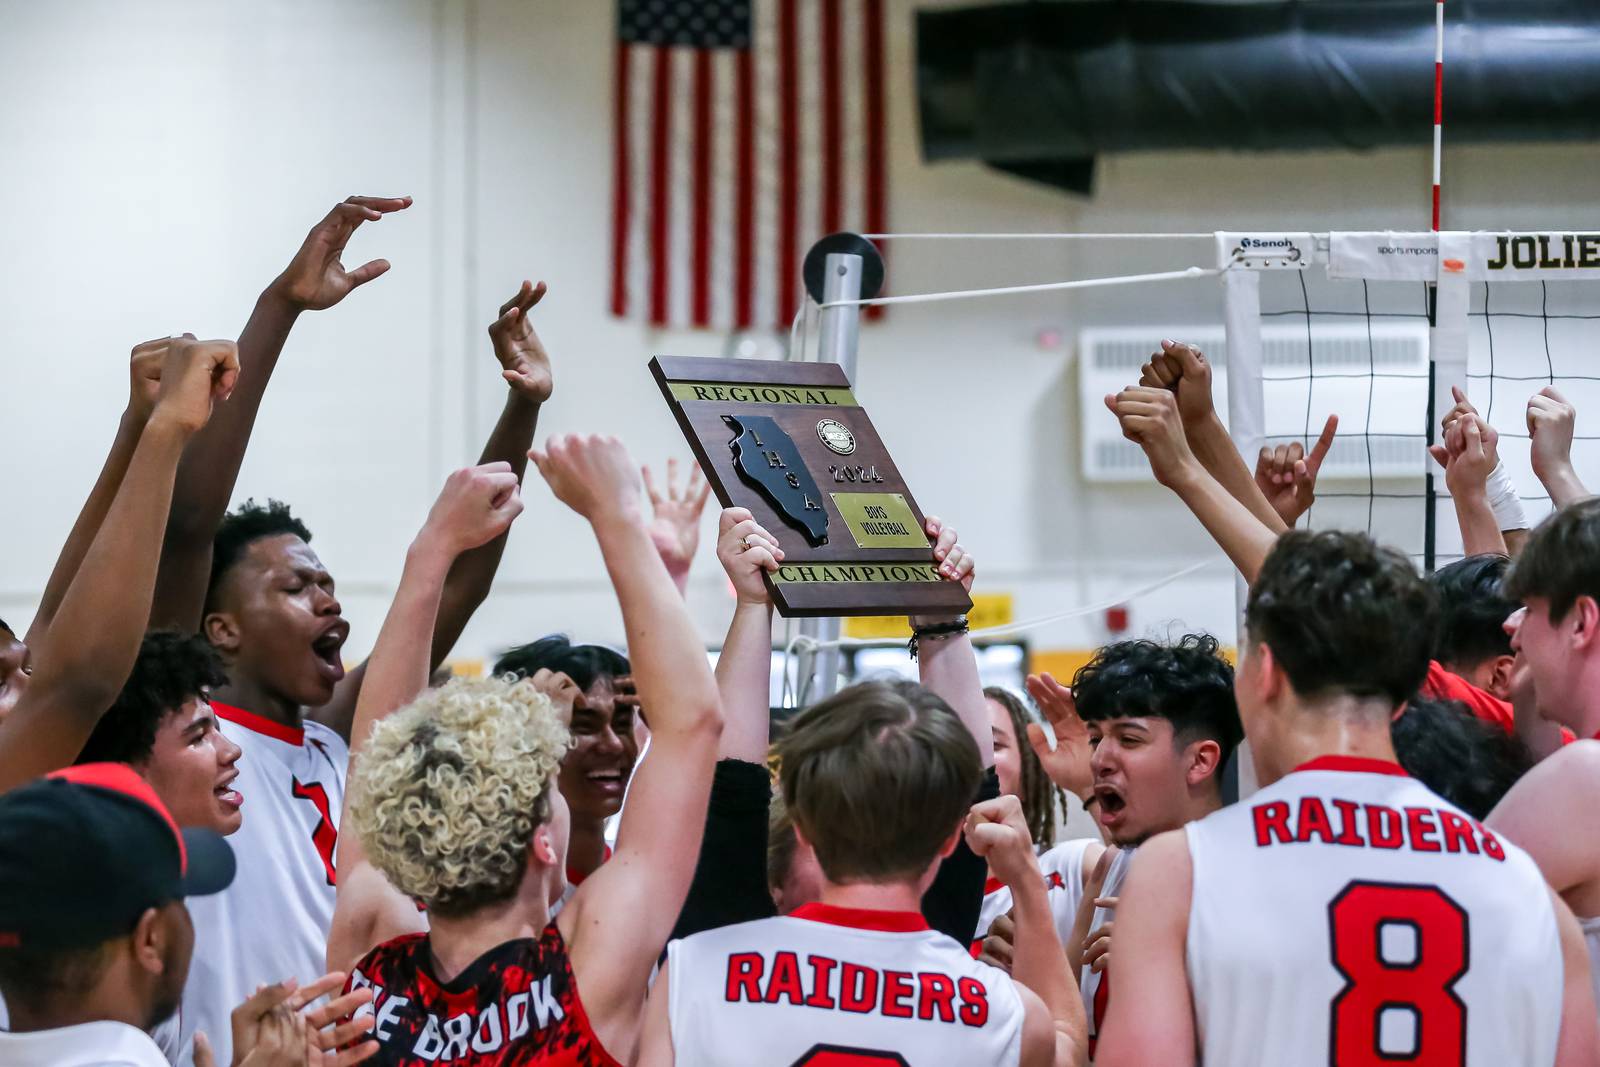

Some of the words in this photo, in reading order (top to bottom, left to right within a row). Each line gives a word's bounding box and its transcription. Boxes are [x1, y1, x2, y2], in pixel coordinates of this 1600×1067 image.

[1252, 237, 1293, 248] Senoh
[1378, 246, 1404, 256] sports
[1405, 246, 1439, 256] imports
[1487, 234, 1600, 270] JOLIE
[691, 385, 838, 406] REGIONAL
[829, 465, 884, 483] 2024
[863, 505, 888, 520] BOYS
[859, 521, 910, 536] VOLLEYBALL
[1252, 796, 1506, 863] RAIDERS
[1328, 879, 1470, 1067] 8
[725, 950, 990, 1028] RAIDERS
[411, 973, 565, 1062] BROOK
